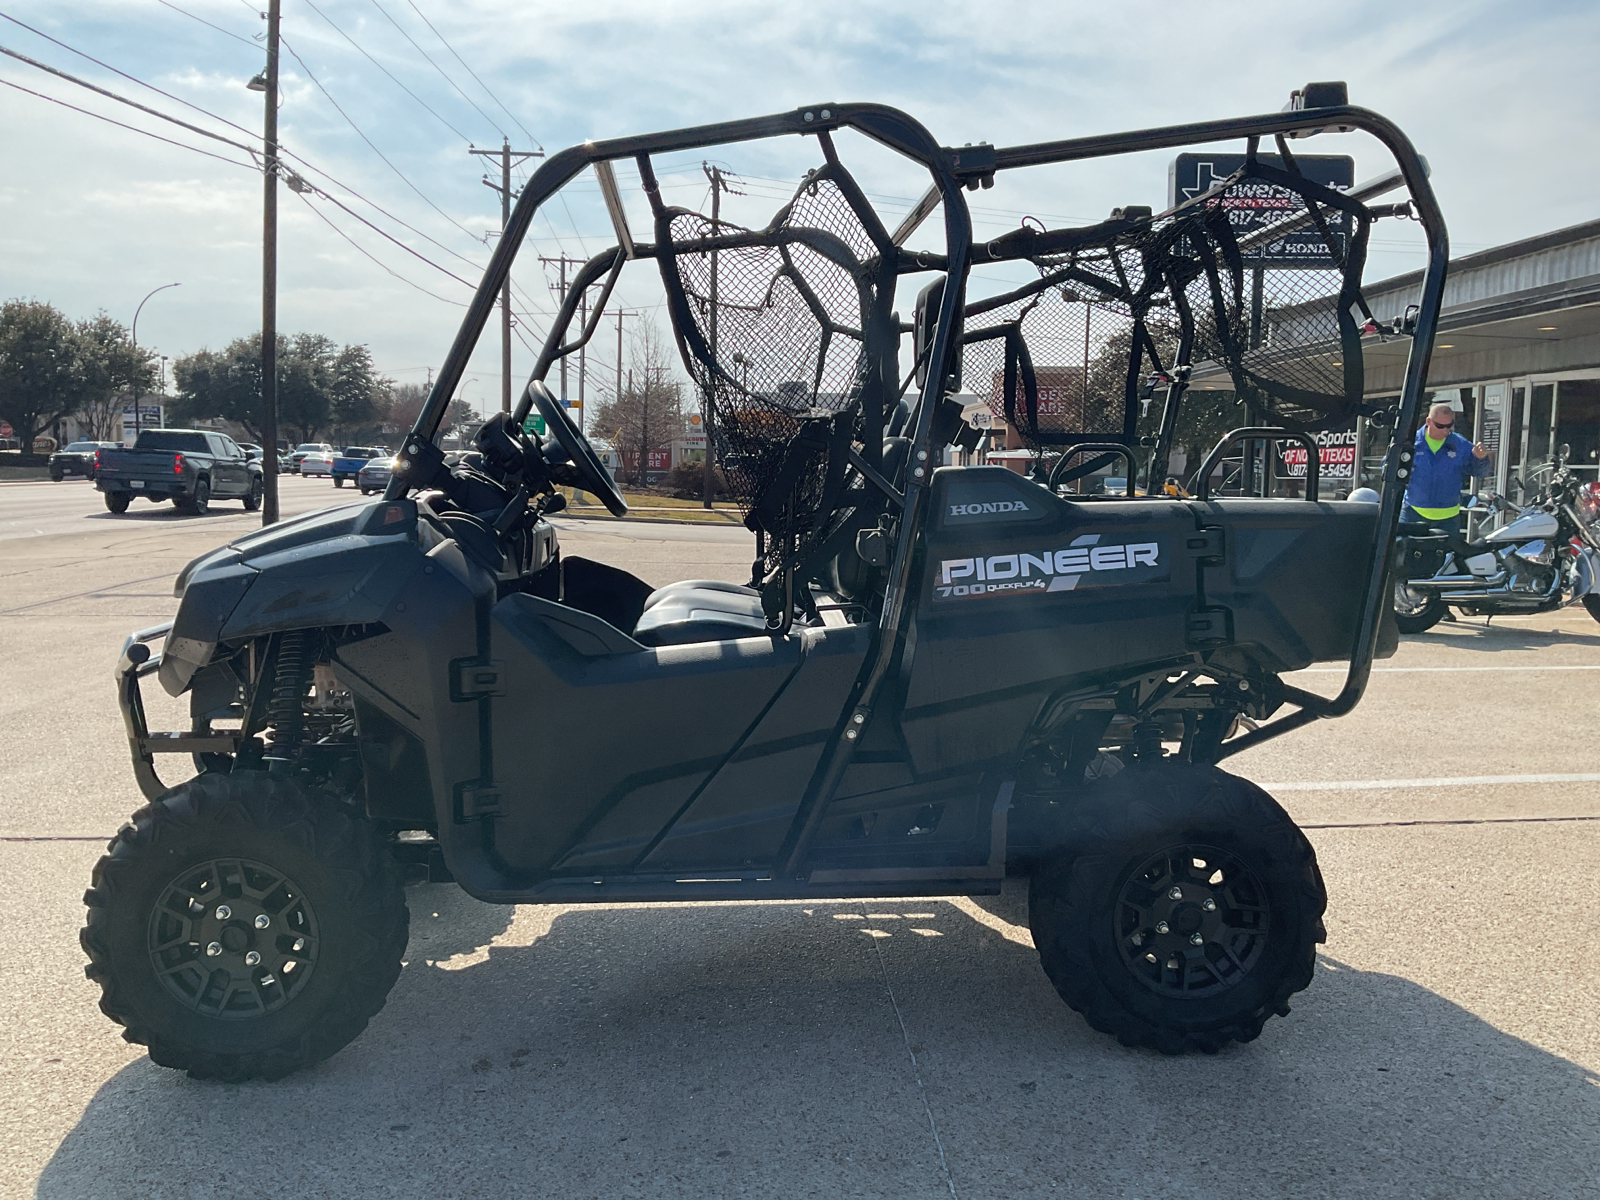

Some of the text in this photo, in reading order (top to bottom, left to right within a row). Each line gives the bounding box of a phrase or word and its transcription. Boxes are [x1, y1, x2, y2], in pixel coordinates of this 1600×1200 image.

[1285, 243, 1331, 254] HOND
[1286, 428, 1357, 448] PorSports
[627, 452, 668, 460] URENT
[1285, 448, 1354, 463] OF NOH TEXAS
[633, 460, 661, 468] KRE
[1292, 463, 1352, 477] 817-5-5454
[950, 500, 1029, 516] HONDA
[941, 542, 1159, 585] PIONEER
[936, 584, 986, 598] 700
